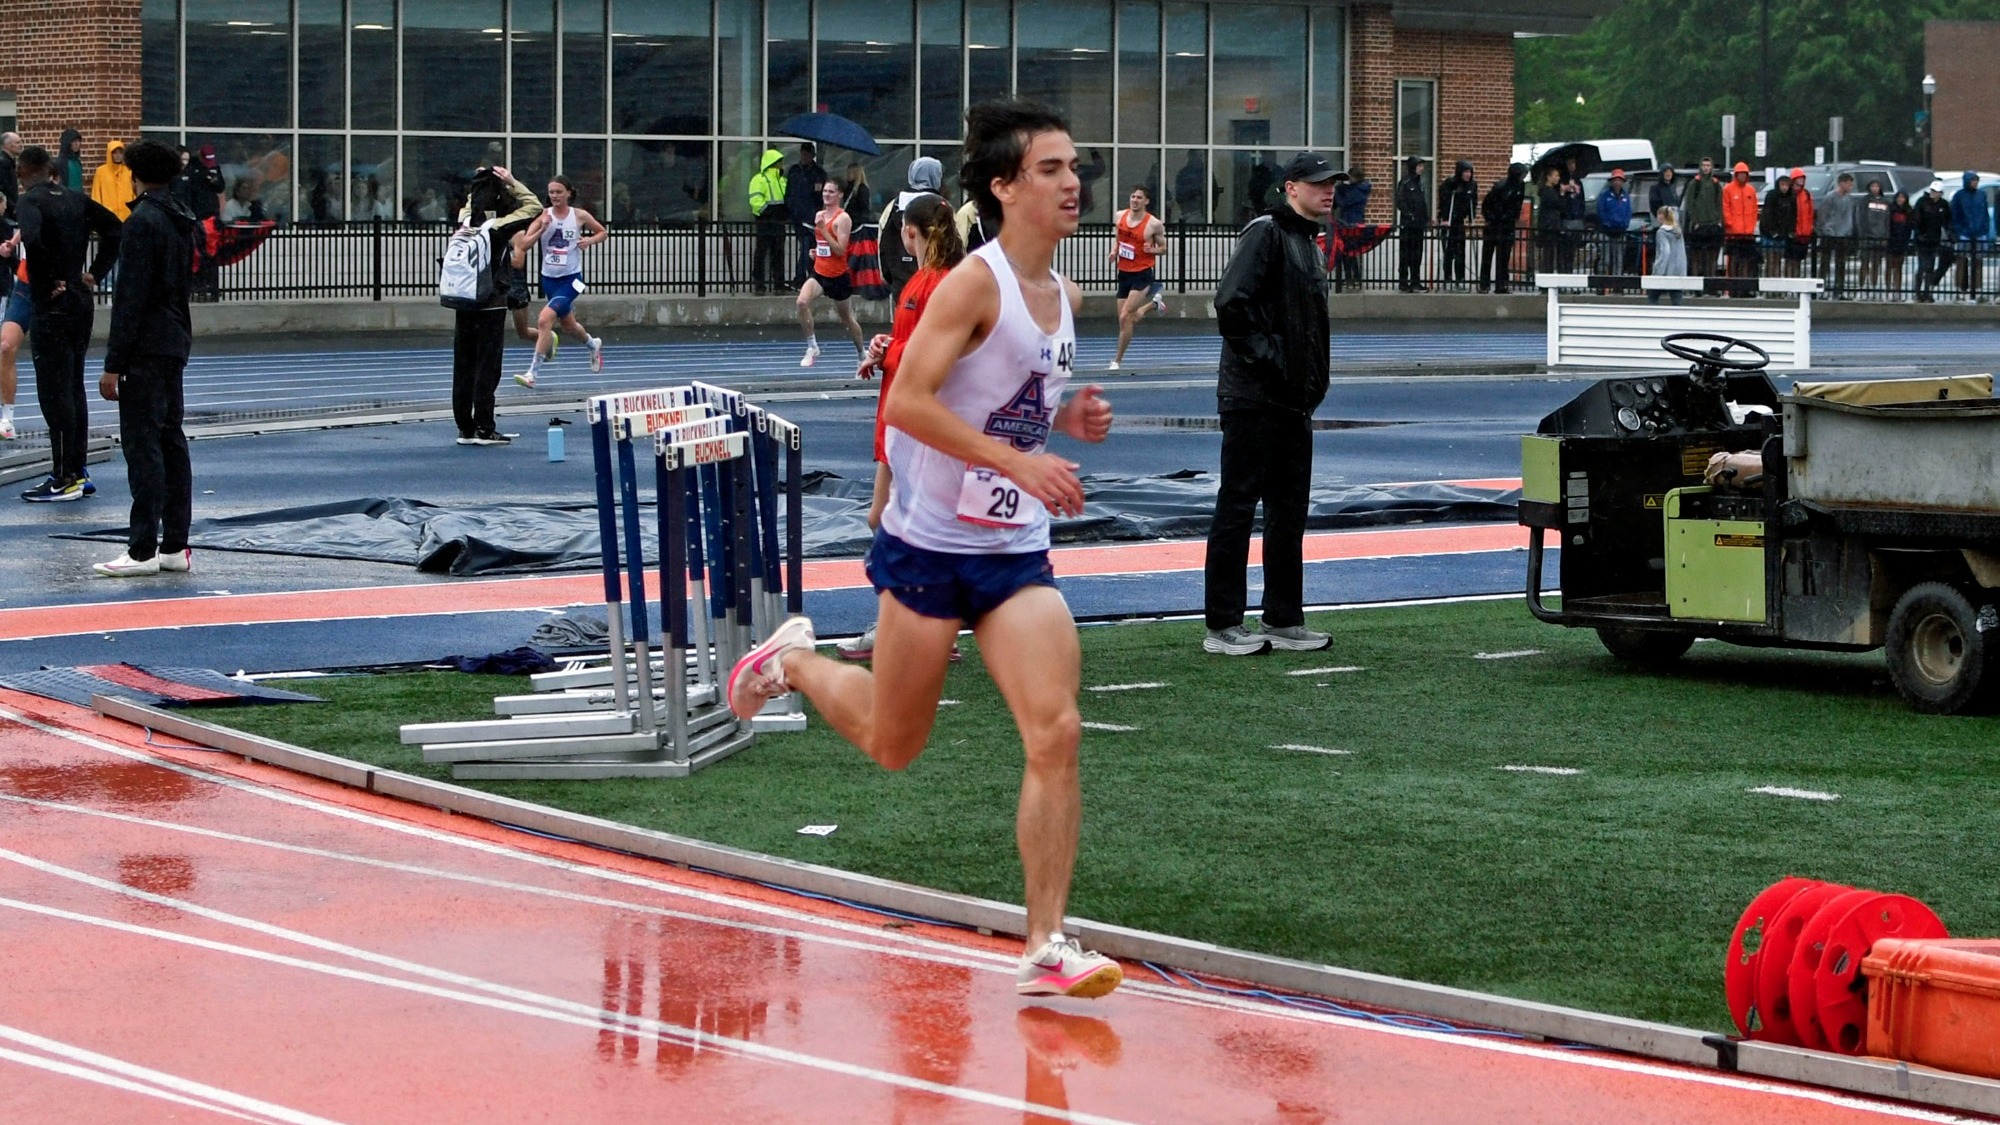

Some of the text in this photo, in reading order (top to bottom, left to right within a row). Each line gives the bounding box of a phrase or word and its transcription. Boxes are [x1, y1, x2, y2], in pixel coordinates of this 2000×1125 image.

[564, 230, 574, 238] 32
[550, 255, 561, 264] 36
[1057, 342, 1074, 372] 48
[623, 393, 666, 413] BUCKNELL
[646, 409, 688, 433] BUCKNELL
[695, 438, 732, 463] BUCKNELL
[986, 486, 1020, 520] 29
